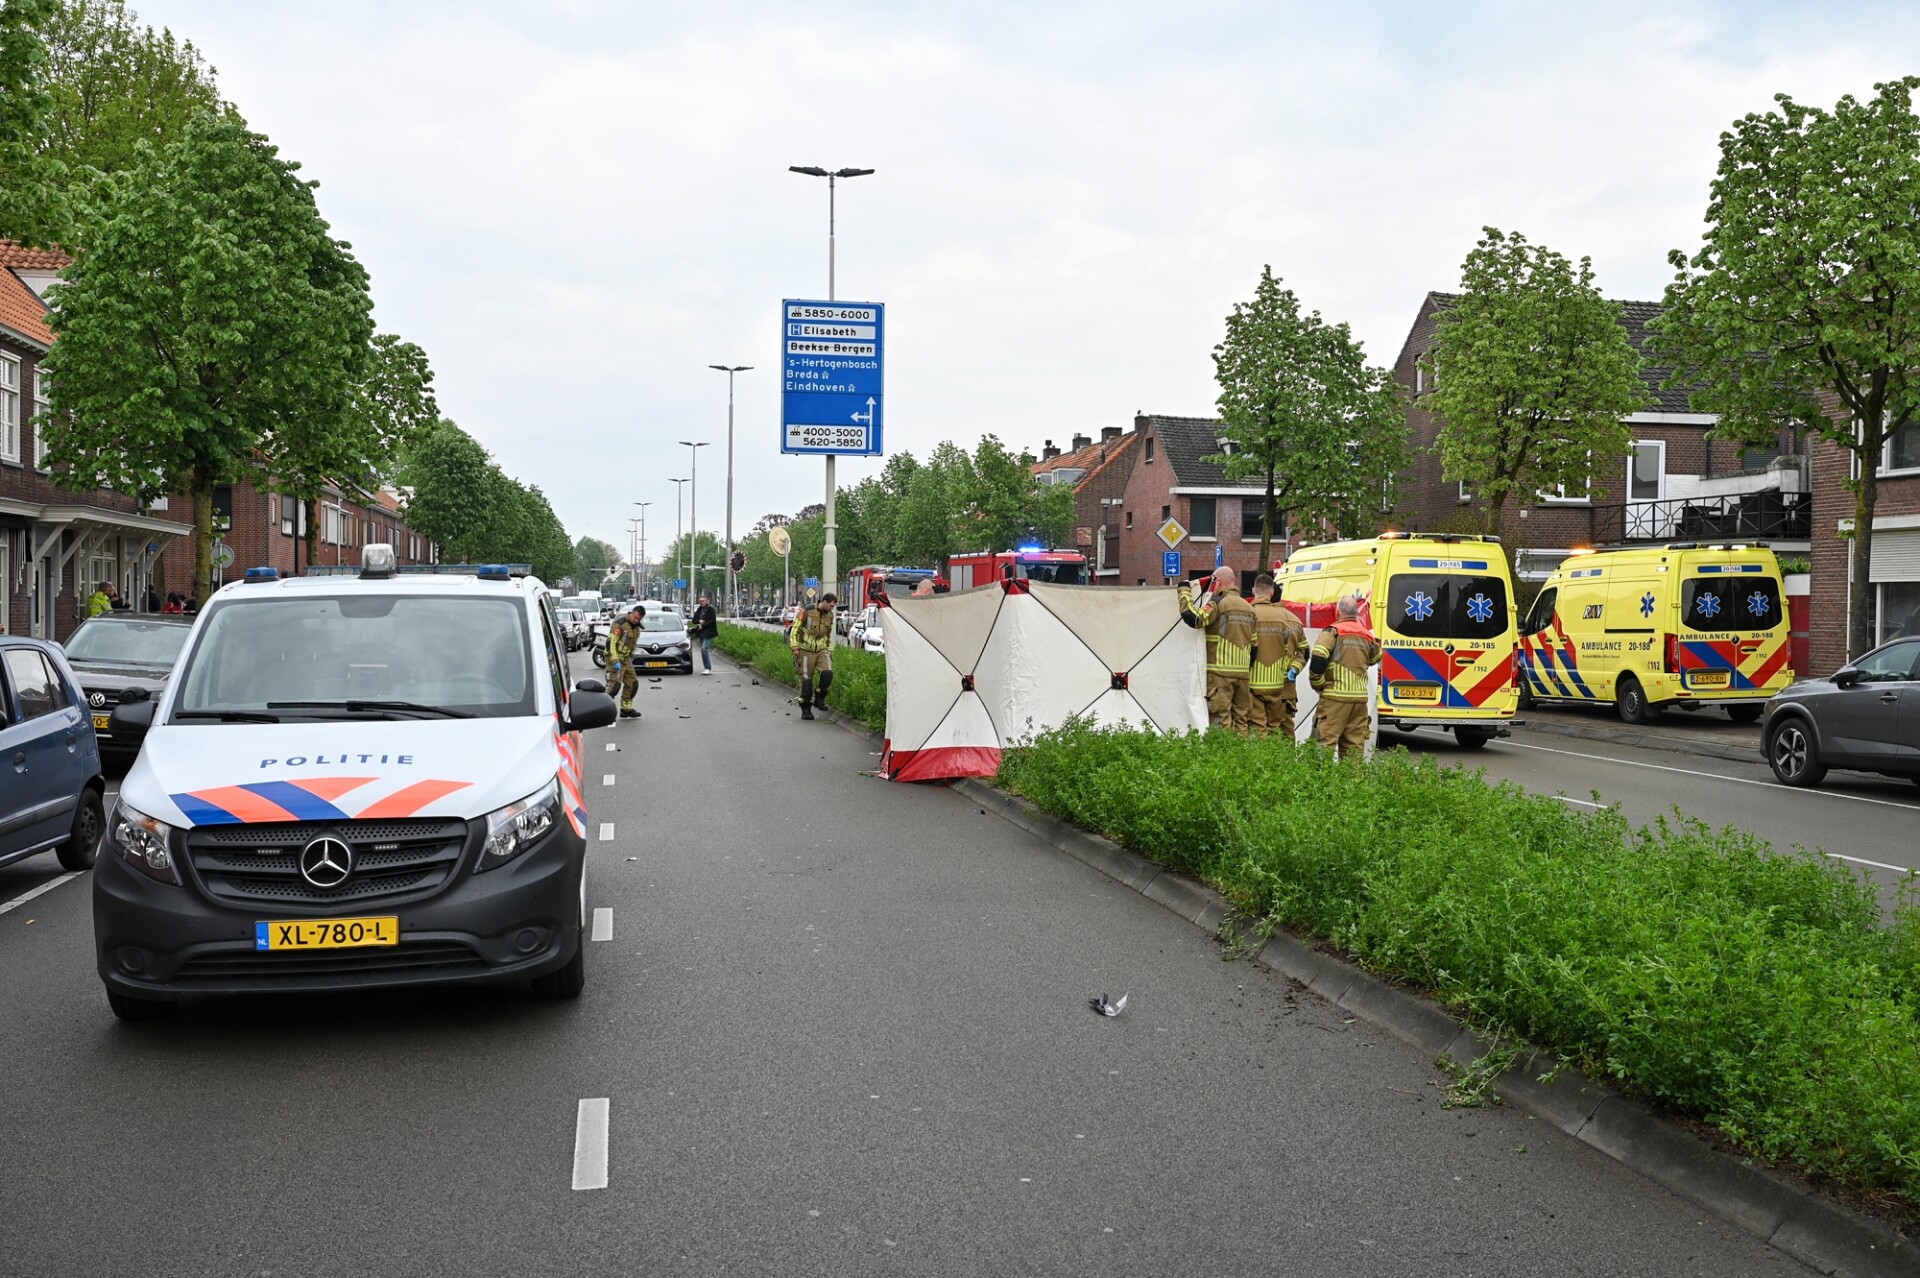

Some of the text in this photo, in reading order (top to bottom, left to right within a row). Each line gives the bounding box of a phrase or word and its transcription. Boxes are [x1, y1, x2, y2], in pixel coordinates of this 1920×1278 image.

[804, 309, 870, 320] 5850-6000
[804, 326, 857, 336] Elisabeth
[790, 342, 873, 355] Beekse Bergen
[787, 358, 878, 370] 's-Hertogenbosch
[786, 370, 819, 379] Breda
[786, 382, 845, 392] Eindhoven
[803, 428, 863, 437] 4000-5000
[803, 437, 863, 447] 5620-5850
[1383, 640, 1444, 648] AMBULANCE
[1470, 641, 1496, 650] 20-185
[1581, 641, 1651, 651] AMBULANCE 20-188
[1650, 661, 1661, 670] 112
[1400, 689, 1434, 697] GDX-37-V
[259, 754, 414, 769] POLITIE
[278, 921, 388, 946] XL-780-L
